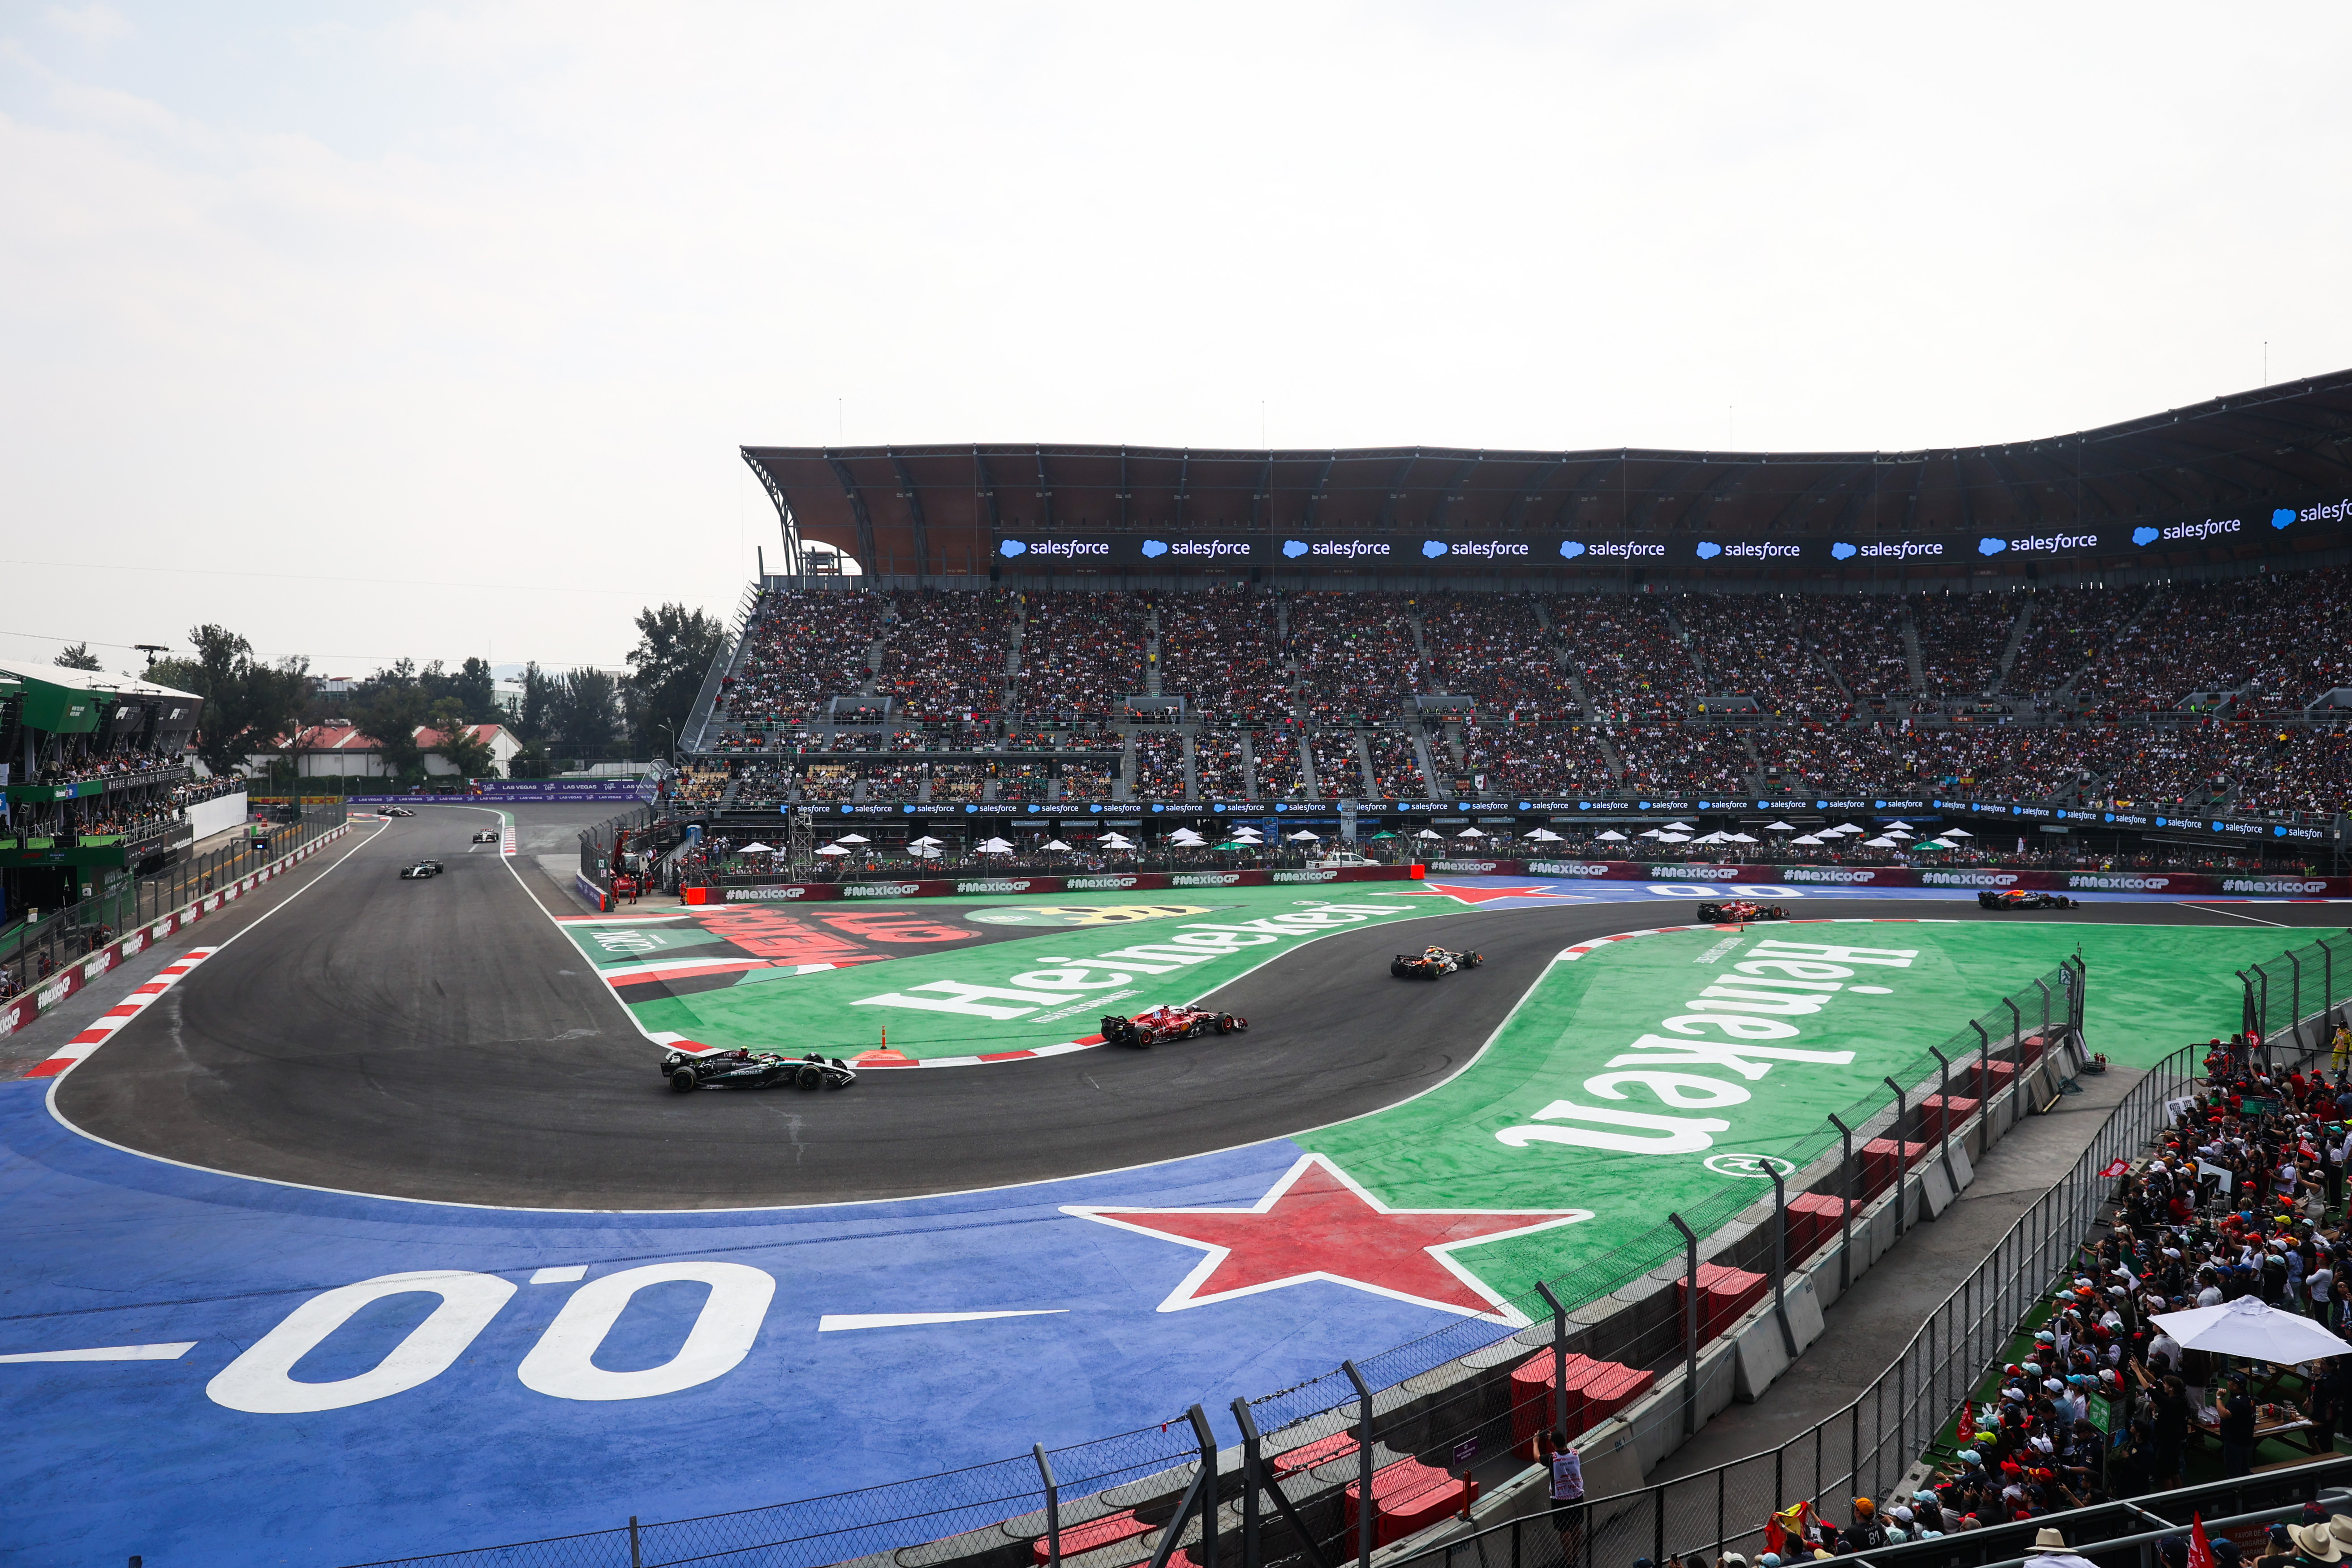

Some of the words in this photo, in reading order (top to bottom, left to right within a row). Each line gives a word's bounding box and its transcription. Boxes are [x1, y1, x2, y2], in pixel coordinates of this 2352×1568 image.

[2164, 519, 2240, 540] salesforce
[1030, 539, 1109, 558] salesforce
[2011, 533, 2097, 552] salesforce
[1172, 540, 1250, 558] salesforce
[1312, 540, 1390, 559] salesforce
[1452, 540, 1529, 559] salesforce
[1589, 541, 1665, 559] salesforce
[1725, 542, 1800, 560] salesforce
[1861, 541, 1943, 560] salesforce
[1222, 586, 1245, 595] CHECO
[108, 779, 125, 790] WHERE
[127, 775, 155, 786] ADRENALINE
[157, 772, 169, 781] MEETS
[171, 769, 189, 779] ELEGANCE
[797, 805, 830, 814] alesforce
[855, 805, 892, 814] salesforce
[917, 804, 955, 814] salesforce
[979, 804, 1017, 814] salesforce
[1042, 804, 1079, 814] salesforce
[1103, 804, 1141, 813] salesforce
[1166, 804, 1203, 813] salesforce
[1228, 803, 1264, 813] salesforce
[1289, 803, 1326, 812] salesforce
[1356, 803, 1387, 812] alesforce
[1411, 802, 1448, 811] salesforce
[1472, 802, 1508, 811] salesforce
[1533, 801, 1568, 811] salesforce
[1593, 801, 1628, 810] salesforce
[1652, 801, 1688, 810] salesforce
[1711, 801, 1747, 810] salesforce
[1770, 800, 1806, 810] salesforce
[1829, 800, 1865, 809] salesforce
[1888, 800, 1923, 809] salesforce
[1942, 801, 1965, 810] salesforce
[1981, 804, 2006, 814] salesforce
[2022, 807, 2049, 817] salesforce
[2067, 809, 2096, 821] salesforce
[2116, 814, 2146, 825] salesforce
[2168, 818, 2202, 829] salesforce
[2225, 822, 2262, 834] salesforce
[1430, 862, 1496, 871] #MexicoGP
[1529, 862, 1608, 875] #MexicoGP
[1651, 866, 1739, 879] #MexicoGP
[104, 870, 116, 885] WHEN
[1172, 874, 1240, 885] #MexicoGP
[1273, 870, 1337, 882] #MexicoGP
[1783, 869, 1875, 883] #MexicoGP
[1922, 872, 2018, 886] #MexicoGP
[2069, 873, 2169, 890] #MexicoGP
[242, 877, 254, 891] #MexicoGP
[957, 880, 1031, 892] #MexicoGP
[1067, 877, 1137, 888] #MexicoGP
[2223, 879, 2327, 896] #MexicoGP
[225, 886, 238, 901] #MexicoGP
[726, 888, 805, 900] #MexicoGP
[844, 884, 919, 896] #MexicoGP
[204, 896, 219, 912] #MexicoGP
[180, 906, 197, 925] #MexicoGP
[152, 919, 172, 939] #MexicoGP
[811, 911, 983, 943] CITY
[686, 909, 896, 967] MEXICO
[122, 934, 143, 956] #MexicoGP
[84, 952, 111, 979] #MexicoGP
[849, 904, 1416, 1021] Heineken
[38, 975, 70, 1009] #MexicoGP
[1495, 939, 1919, 1155] Heineken
[1456, 1446, 1476, 1458] PHOTOGRAPHERS
[1868, 1529, 1880, 1545] 81
[2242, 1548, 2265, 1557] BARAND
